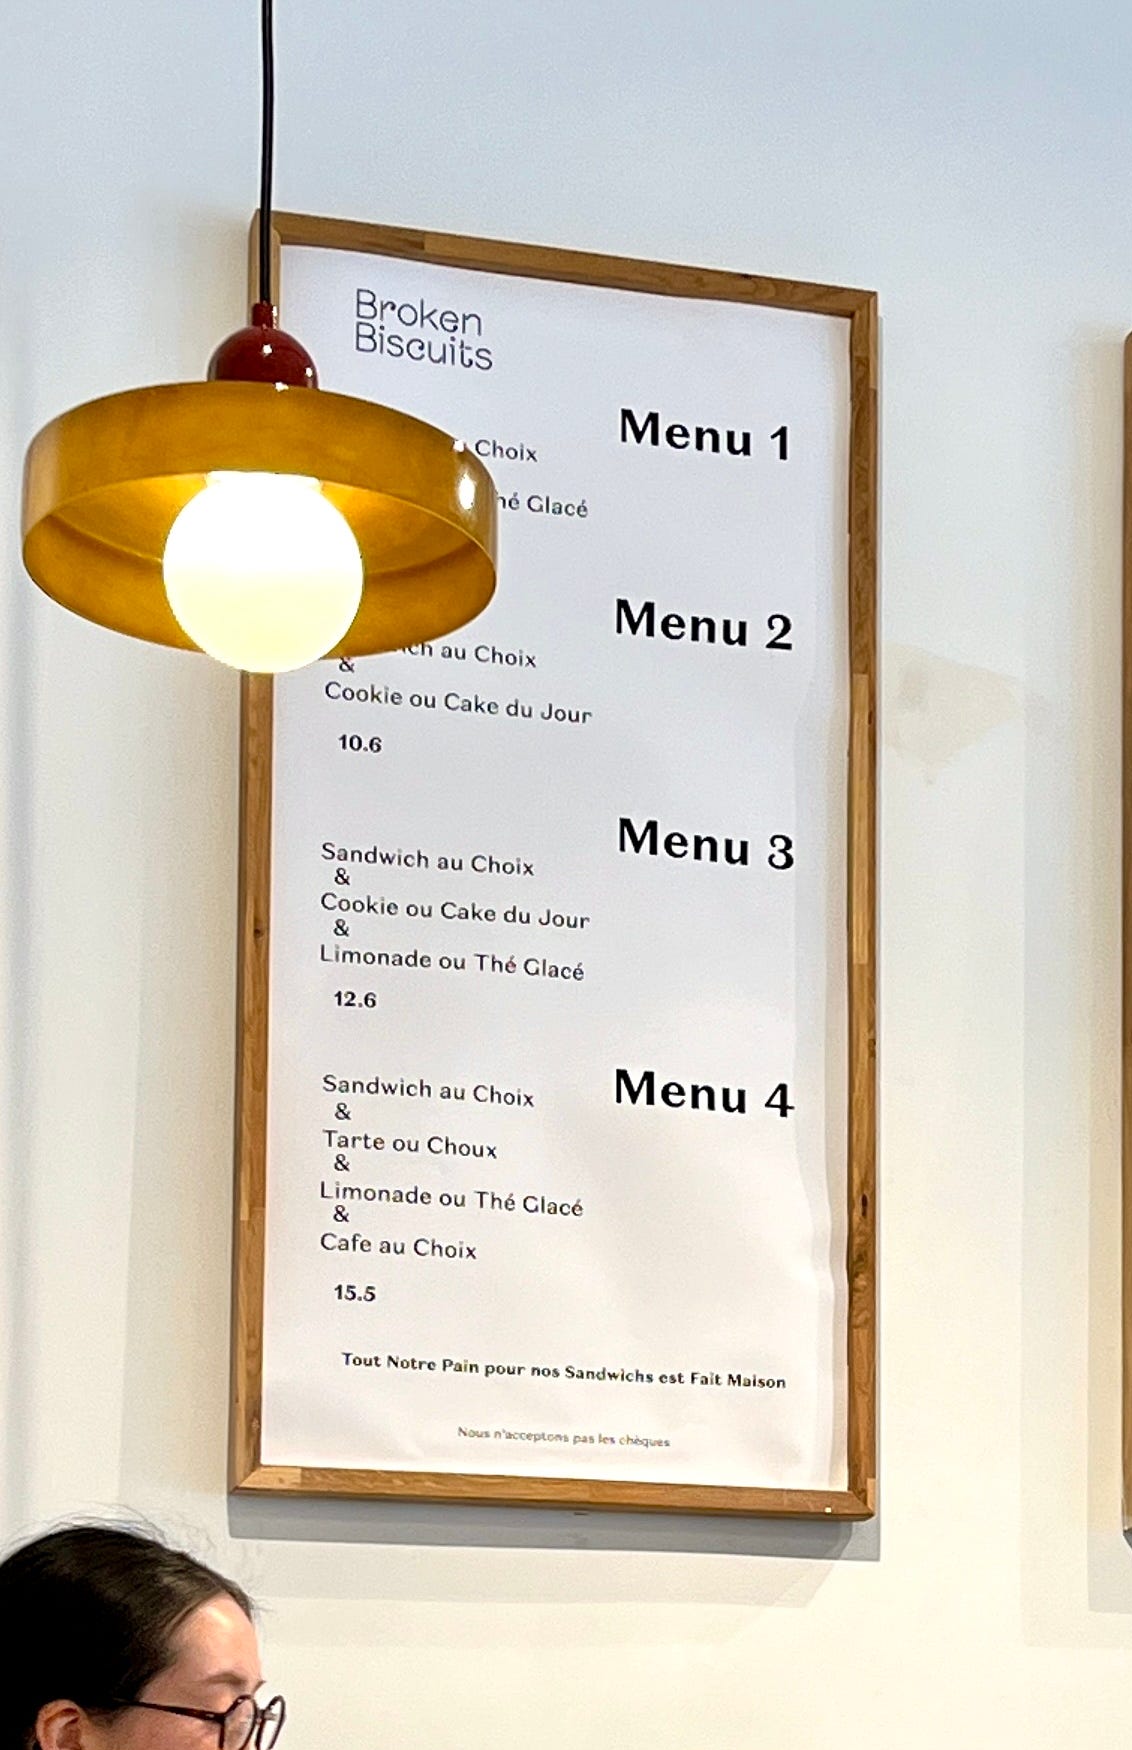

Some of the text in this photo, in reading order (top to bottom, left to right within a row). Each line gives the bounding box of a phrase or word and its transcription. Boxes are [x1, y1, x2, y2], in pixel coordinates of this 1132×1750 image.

[356, 287, 483, 337] Broken
[355, 322, 493, 371] Biscuits
[619, 408, 791, 461] Menu 1
[475, 439, 537, 462] Choix
[527, 495, 588, 518] Glacé
[614, 597, 794, 651] Menu 2
[338, 657, 354, 673] &
[440, 646, 466, 660] au
[474, 644, 536, 668] Choix
[325, 681, 592, 724] Cookie ou Cake du Jour
[338, 734, 382, 753] 10.6
[618, 817, 795, 871] Menu 3
[321, 841, 535, 877] Sandwich au Choix
[334, 867, 351, 886] &
[320, 892, 591, 930] Cookie ou Cake du Jour
[333, 919, 350, 937] &
[319, 944, 585, 982] Limonade ou Thé Glacé
[333, 990, 377, 1009] 12.6
[322, 1074, 535, 1108] Sandwich au Choix
[615, 1068, 795, 1118] Menu 4
[334, 1102, 351, 1121] &
[322, 1128, 498, 1160] Tarte ou Choux
[334, 1154, 350, 1172] &
[319, 1180, 584, 1218] Limonade ou Thé Glacé
[333, 1205, 349, 1223] &
[320, 1233, 477, 1260] Cafe au Choix
[333, 1284, 376, 1303] 15.5
[341, 1352, 787, 1390] Tout Notre Pain pour nos Sandwichs est Fait Maison
[457, 1426, 671, 1449] Nous n'acceptons pas les chèques
